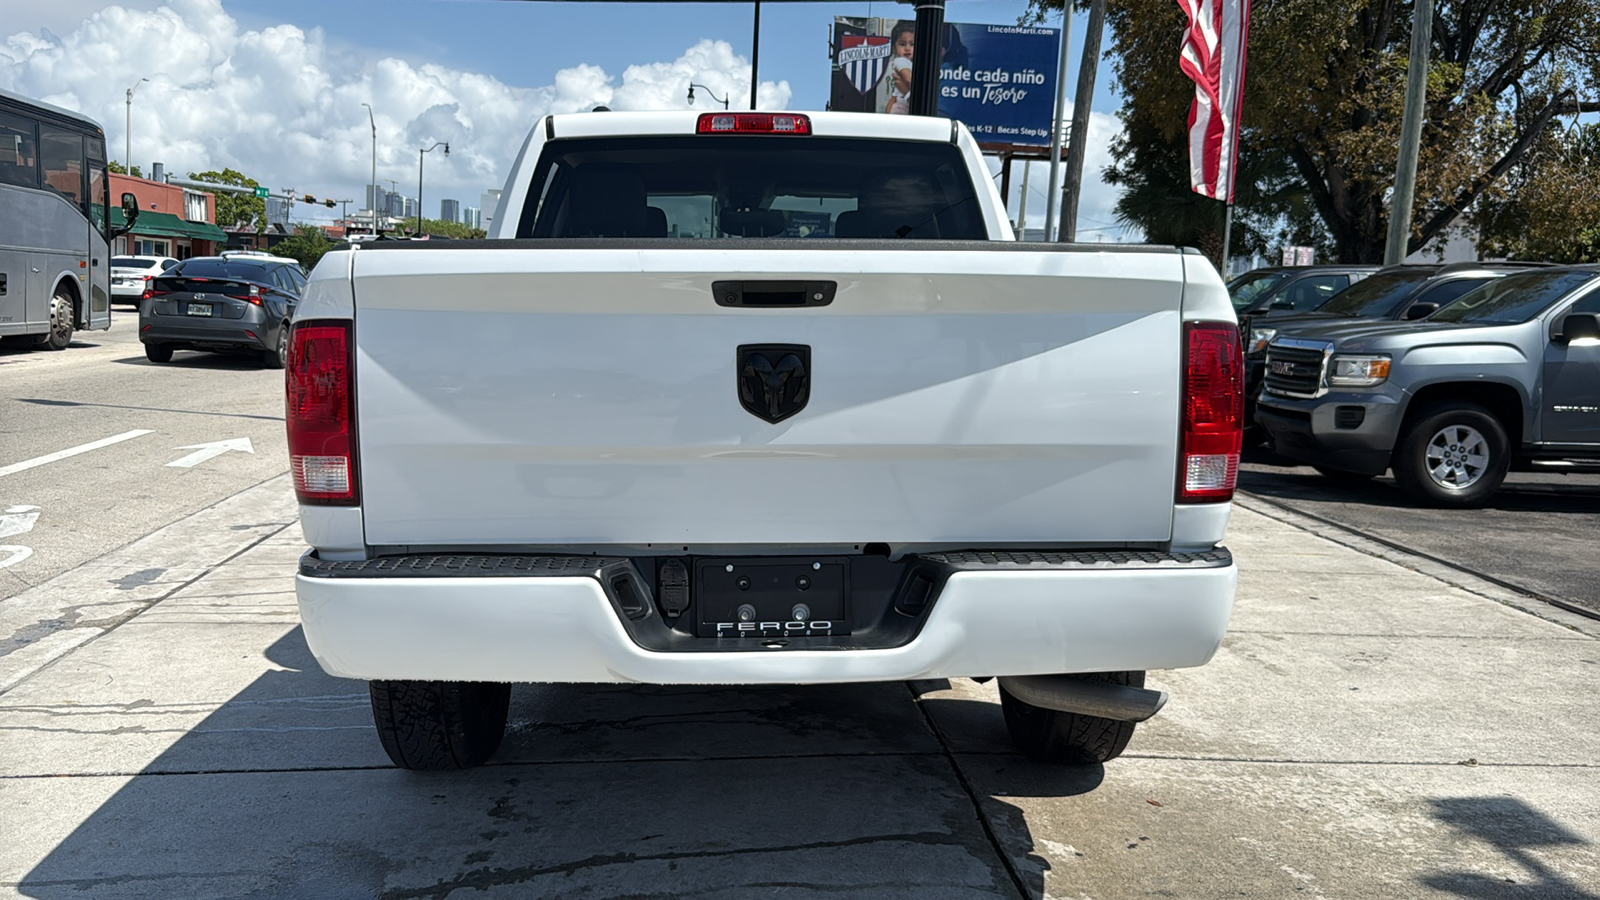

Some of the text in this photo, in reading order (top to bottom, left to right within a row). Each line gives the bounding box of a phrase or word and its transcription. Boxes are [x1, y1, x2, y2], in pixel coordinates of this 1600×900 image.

[987, 25, 1054, 36] LincolnMarti.com
[974, 67, 1009, 83] cada
[1012, 69, 1045, 85] niño
[941, 83, 1027, 105] es un Tesoro
[977, 125, 993, 133] K-12
[997, 126, 1019, 135] Becas
[1020, 127, 1036, 137] Step
[1037, 128, 1048, 138] Up
[717, 621, 832, 631] FERCO
